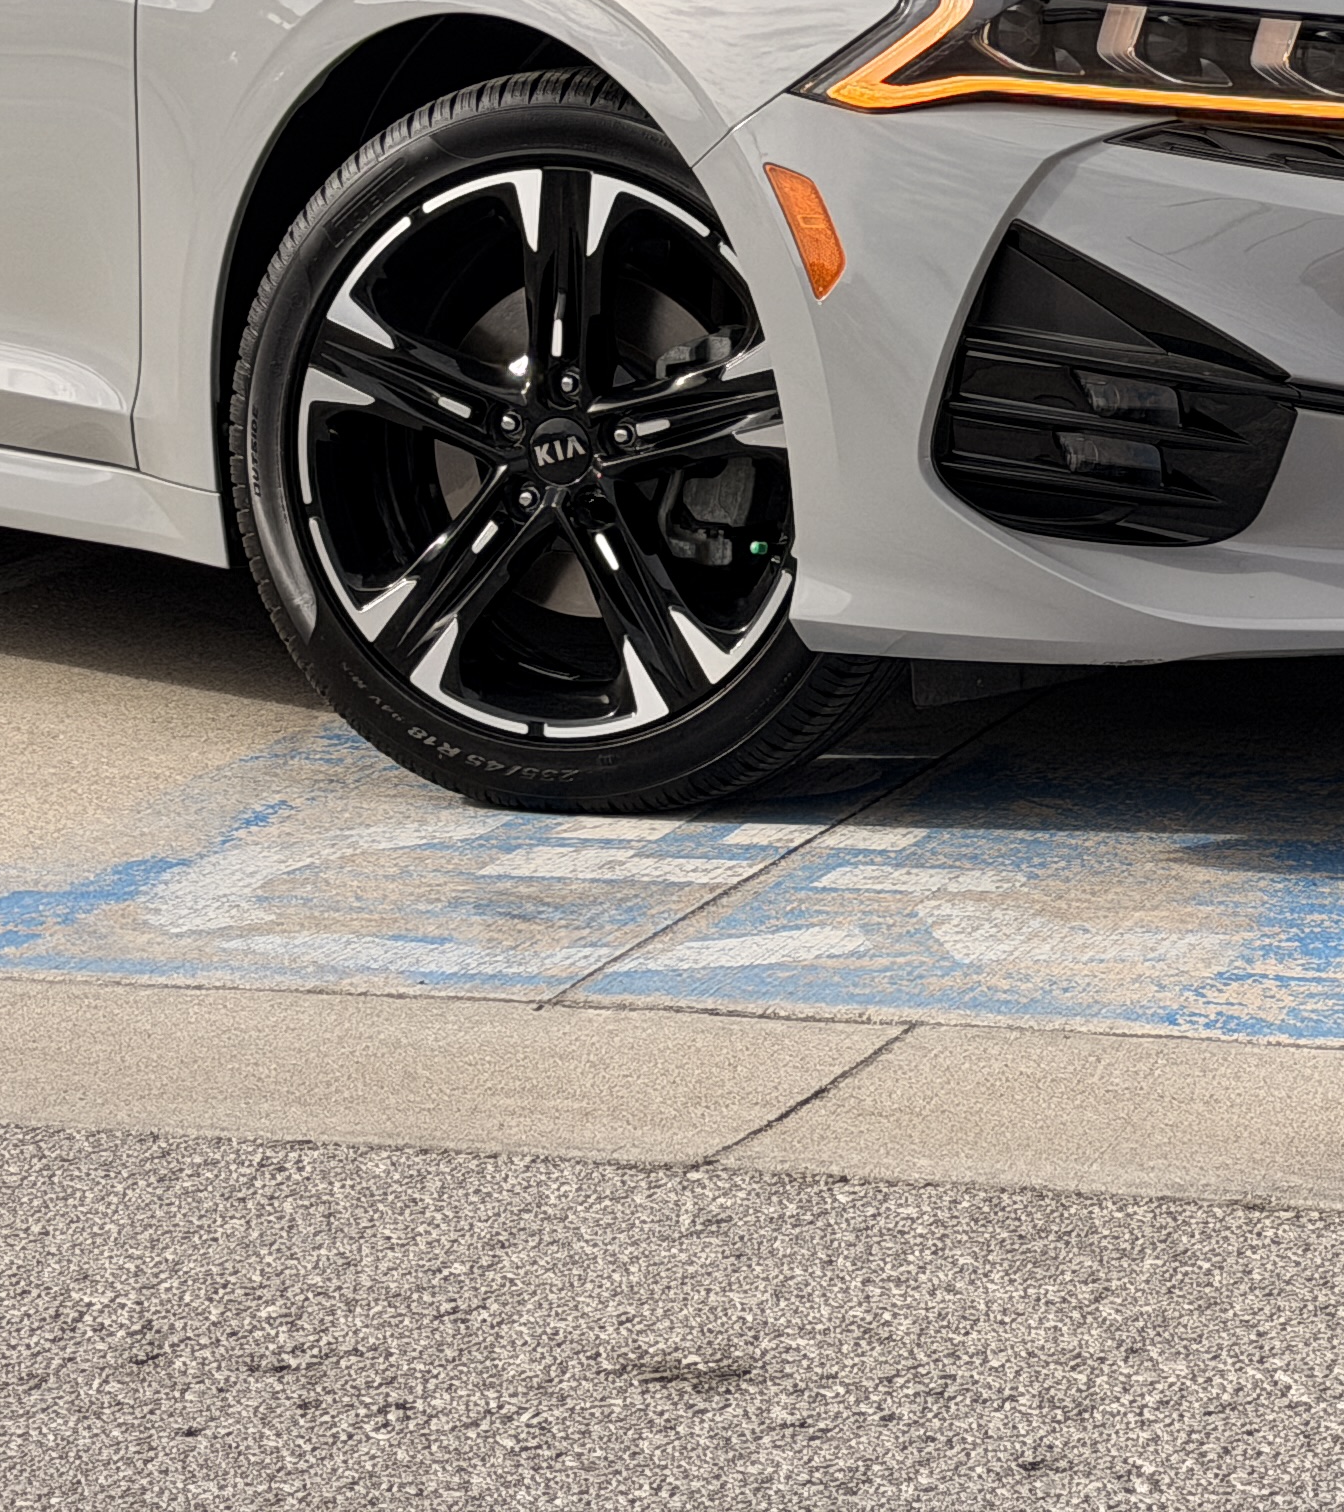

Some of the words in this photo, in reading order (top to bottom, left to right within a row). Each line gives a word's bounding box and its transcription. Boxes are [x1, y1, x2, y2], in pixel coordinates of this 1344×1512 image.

[533, 435, 586, 467] KIA
[407, 726, 462, 759] R18
[464, 754, 581, 783] 235/45
